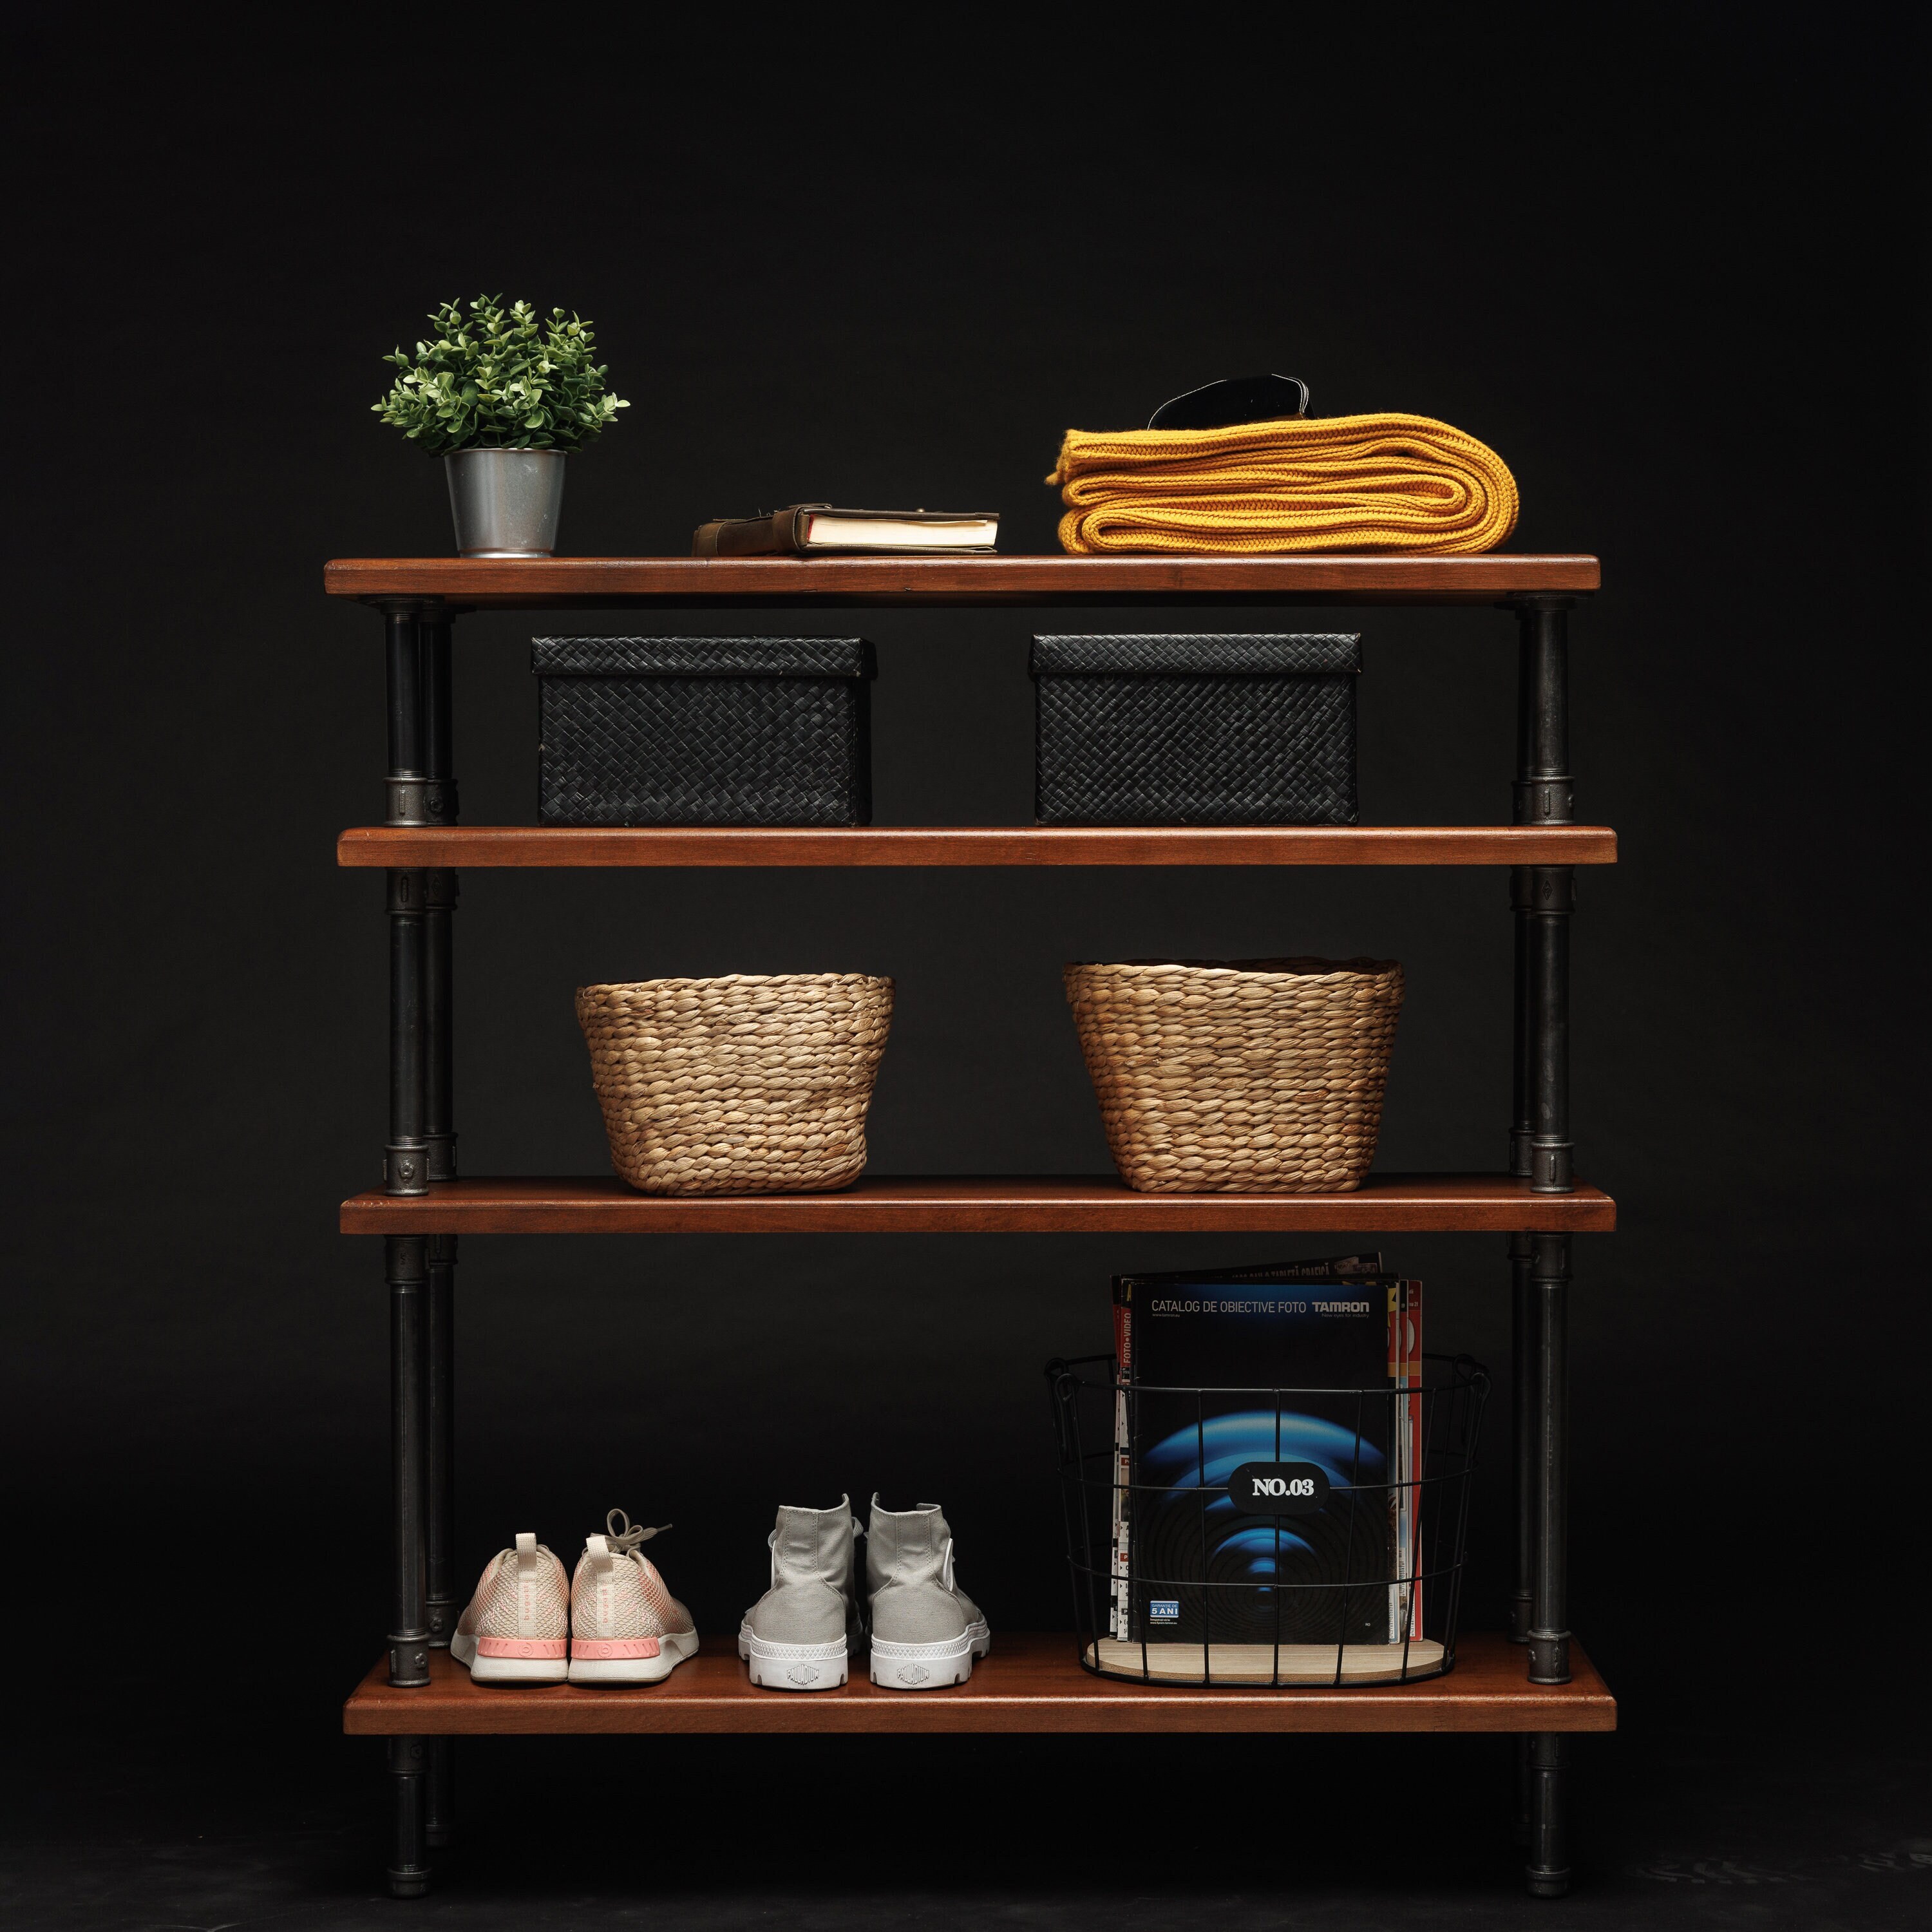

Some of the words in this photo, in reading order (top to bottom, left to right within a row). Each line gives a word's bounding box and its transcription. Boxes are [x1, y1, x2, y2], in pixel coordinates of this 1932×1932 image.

[1151, 1300, 1200, 1312] CATALOG
[1203, 1300, 1217, 1312] DE
[1220, 1301, 1275, 1313] OBIECTIVE
[1278, 1302, 1307, 1313] FOTO
[1312, 1302, 1370, 1312] TAMRON
[1252, 1478, 1314, 1497] NO.03
[786, 1663, 820, 1686] PALLADIUM
[896, 1663, 930, 1685] PALLADIUM
